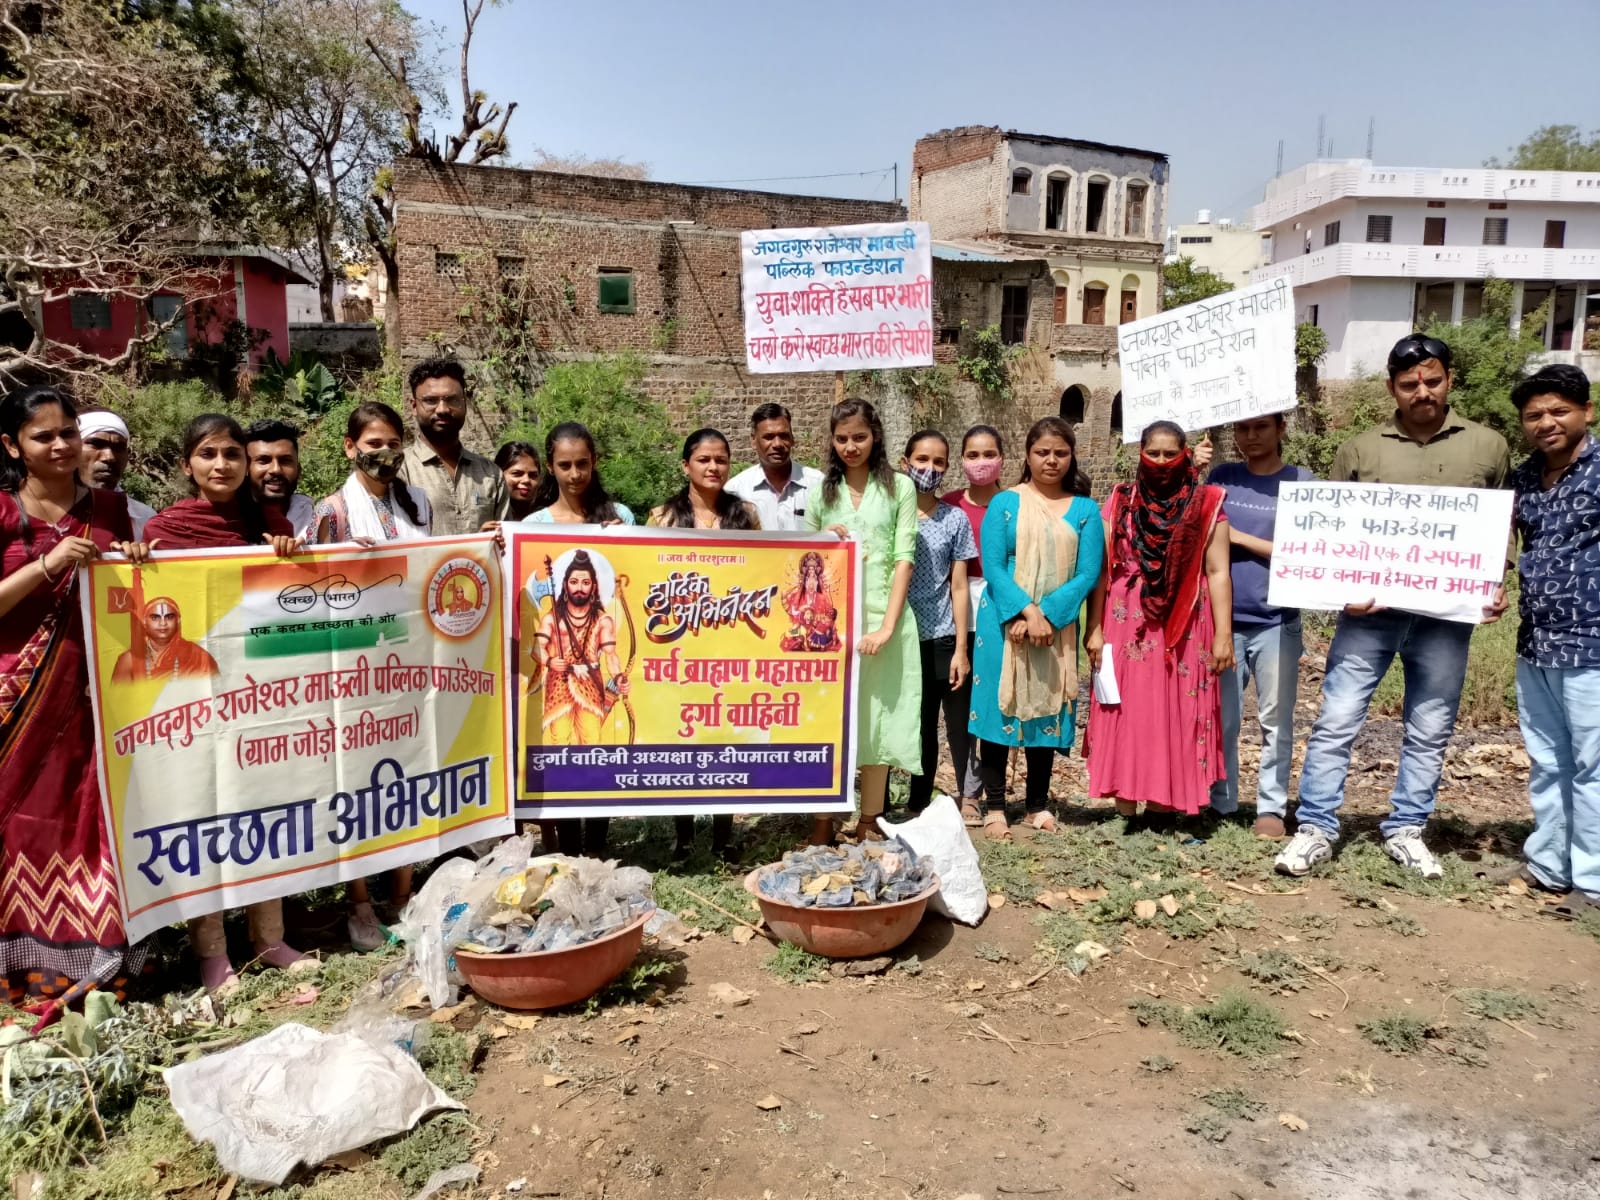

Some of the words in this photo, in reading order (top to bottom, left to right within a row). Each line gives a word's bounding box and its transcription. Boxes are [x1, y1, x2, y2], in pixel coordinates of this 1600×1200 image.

[756, 291, 789, 324] युवा
[791, 282, 835, 316] शक्ति
[875, 285, 898, 311] पर
[898, 274, 934, 310] भारी
[749, 328, 779, 365] चलो
[781, 328, 805, 360] करो
[841, 332, 876, 360] भारत
[875, 322, 893, 357] की
[282, 595, 313, 605] स्वच्छ
[327, 592, 355, 602] भारत
[645, 584, 778, 643] अभिनंदन
[250, 626, 271, 638] एक
[277, 624, 306, 634] कदम
[312, 619, 354, 631] स्वच्छता
[359, 614, 373, 626] की
[378, 612, 396, 624] ओर
[216, 673, 300, 722] राजेश्वर
[374, 653, 429, 694] पब्लिक
[431, 657, 495, 696] फाउंडेशन
[643, 648, 680, 682] सर्व
[755, 659, 839, 687] महासभा
[678, 693, 724, 737] दुर्गा
[727, 692, 800, 730] वाहिनी
[236, 733, 289, 770] (ग्राम
[342, 706, 419, 750] अभियान)
[532, 747, 568, 771] दुर्गा
[572, 747, 628, 766] वाहिनी
[633, 750, 692, 765] अध्यक्षा
[793, 746, 829, 765] शर्मा
[615, 769, 638, 789] एवं
[641, 774, 694, 787] समस्त
[698, 773, 750, 786] सदस्य
[133, 798, 317, 887] स्वच्छता
[327, 758, 490, 846] अभियान
